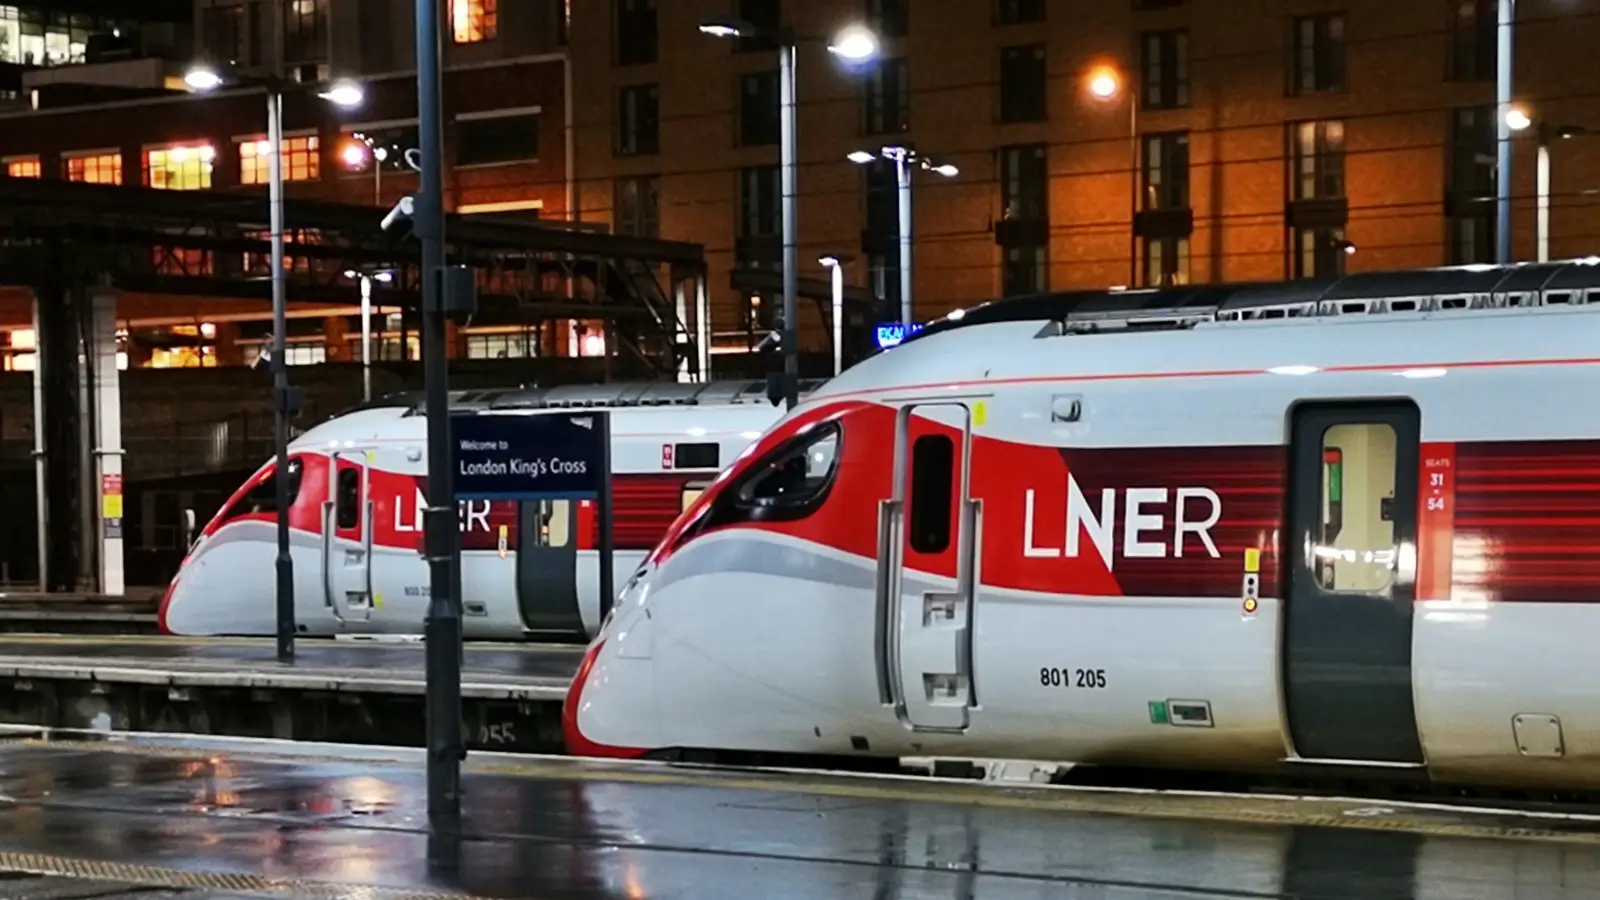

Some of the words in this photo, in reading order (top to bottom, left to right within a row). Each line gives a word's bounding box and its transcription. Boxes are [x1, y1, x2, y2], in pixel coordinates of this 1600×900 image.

[459, 440, 497, 450] Welcome
[498, 440, 509, 450] to
[460, 458, 507, 475] London
[510, 458, 547, 478] King's
[550, 457, 587, 474] Cross
[1429, 472, 1444, 487] 31
[1427, 497, 1444, 511] 54
[1024, 471, 1222, 573] LNER
[1040, 667, 1069, 687] 801
[1075, 668, 1107, 688] 205
